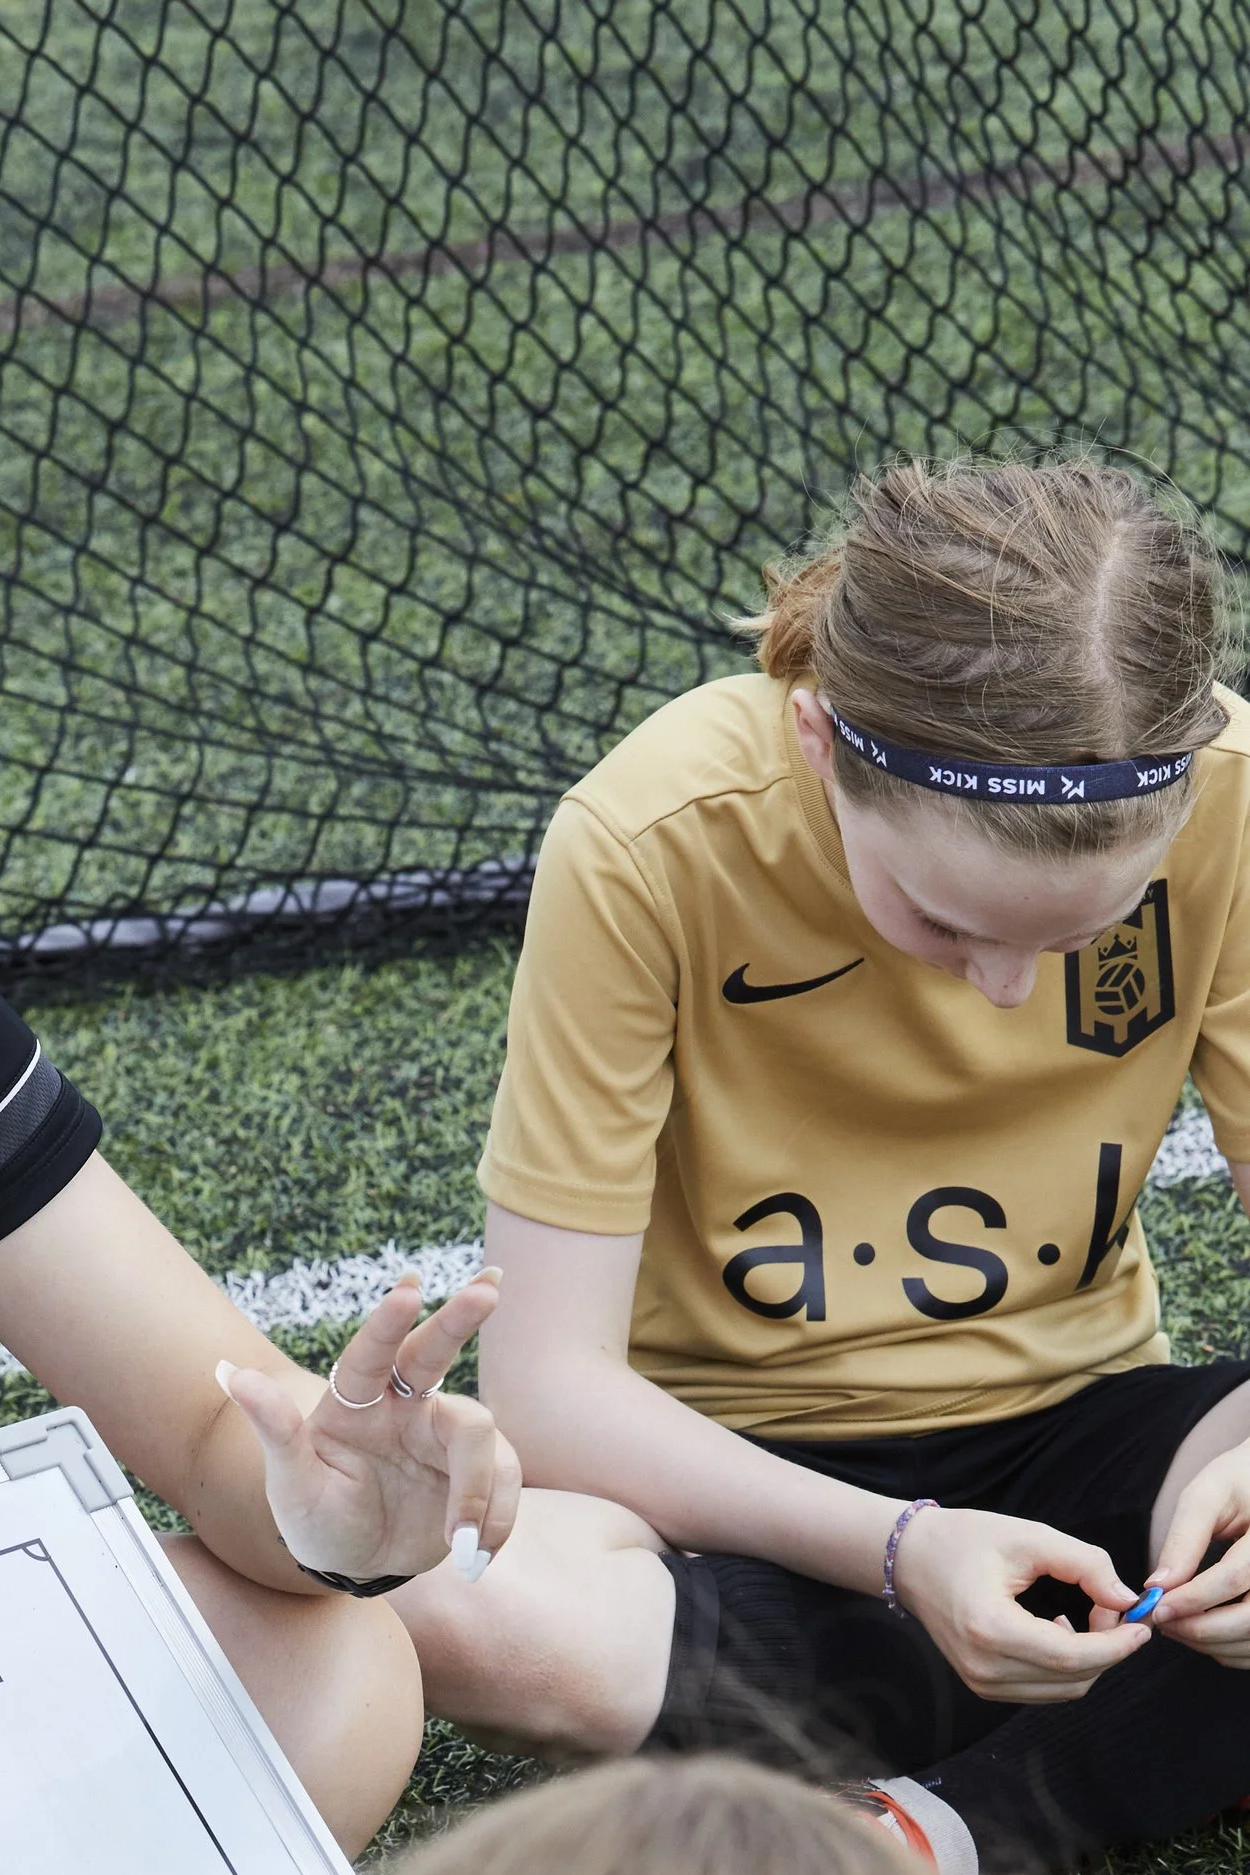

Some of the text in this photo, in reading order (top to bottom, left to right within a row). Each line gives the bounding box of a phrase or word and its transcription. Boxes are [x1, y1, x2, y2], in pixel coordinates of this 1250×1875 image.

[839, 720, 864, 752] MISS
[929, 766, 1045, 795] MISS KICK
[1137, 764, 1171, 788] KICK
